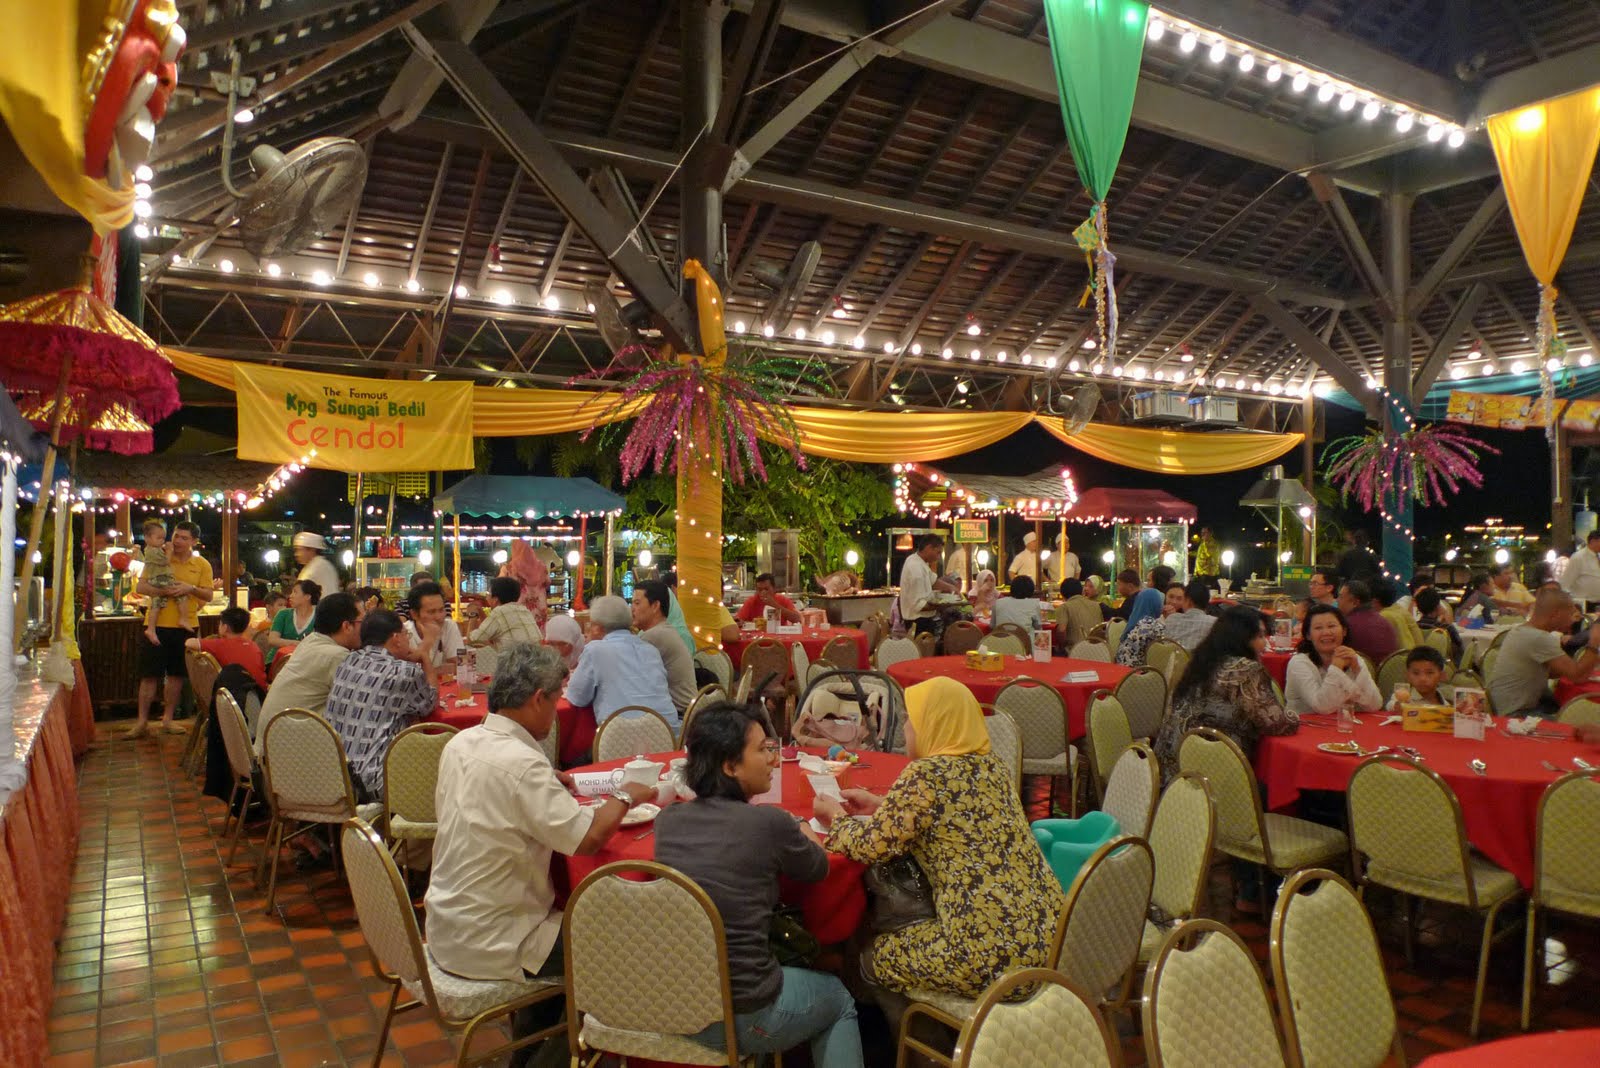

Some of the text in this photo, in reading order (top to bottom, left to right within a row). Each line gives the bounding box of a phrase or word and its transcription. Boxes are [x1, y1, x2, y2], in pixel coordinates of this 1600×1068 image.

[322, 386, 389, 400] The Famous
[286, 392, 426, 420] Kpg Sungai Bedil
[286, 419, 405, 450] Cendol
[960, 530, 984, 538] EASTERN
